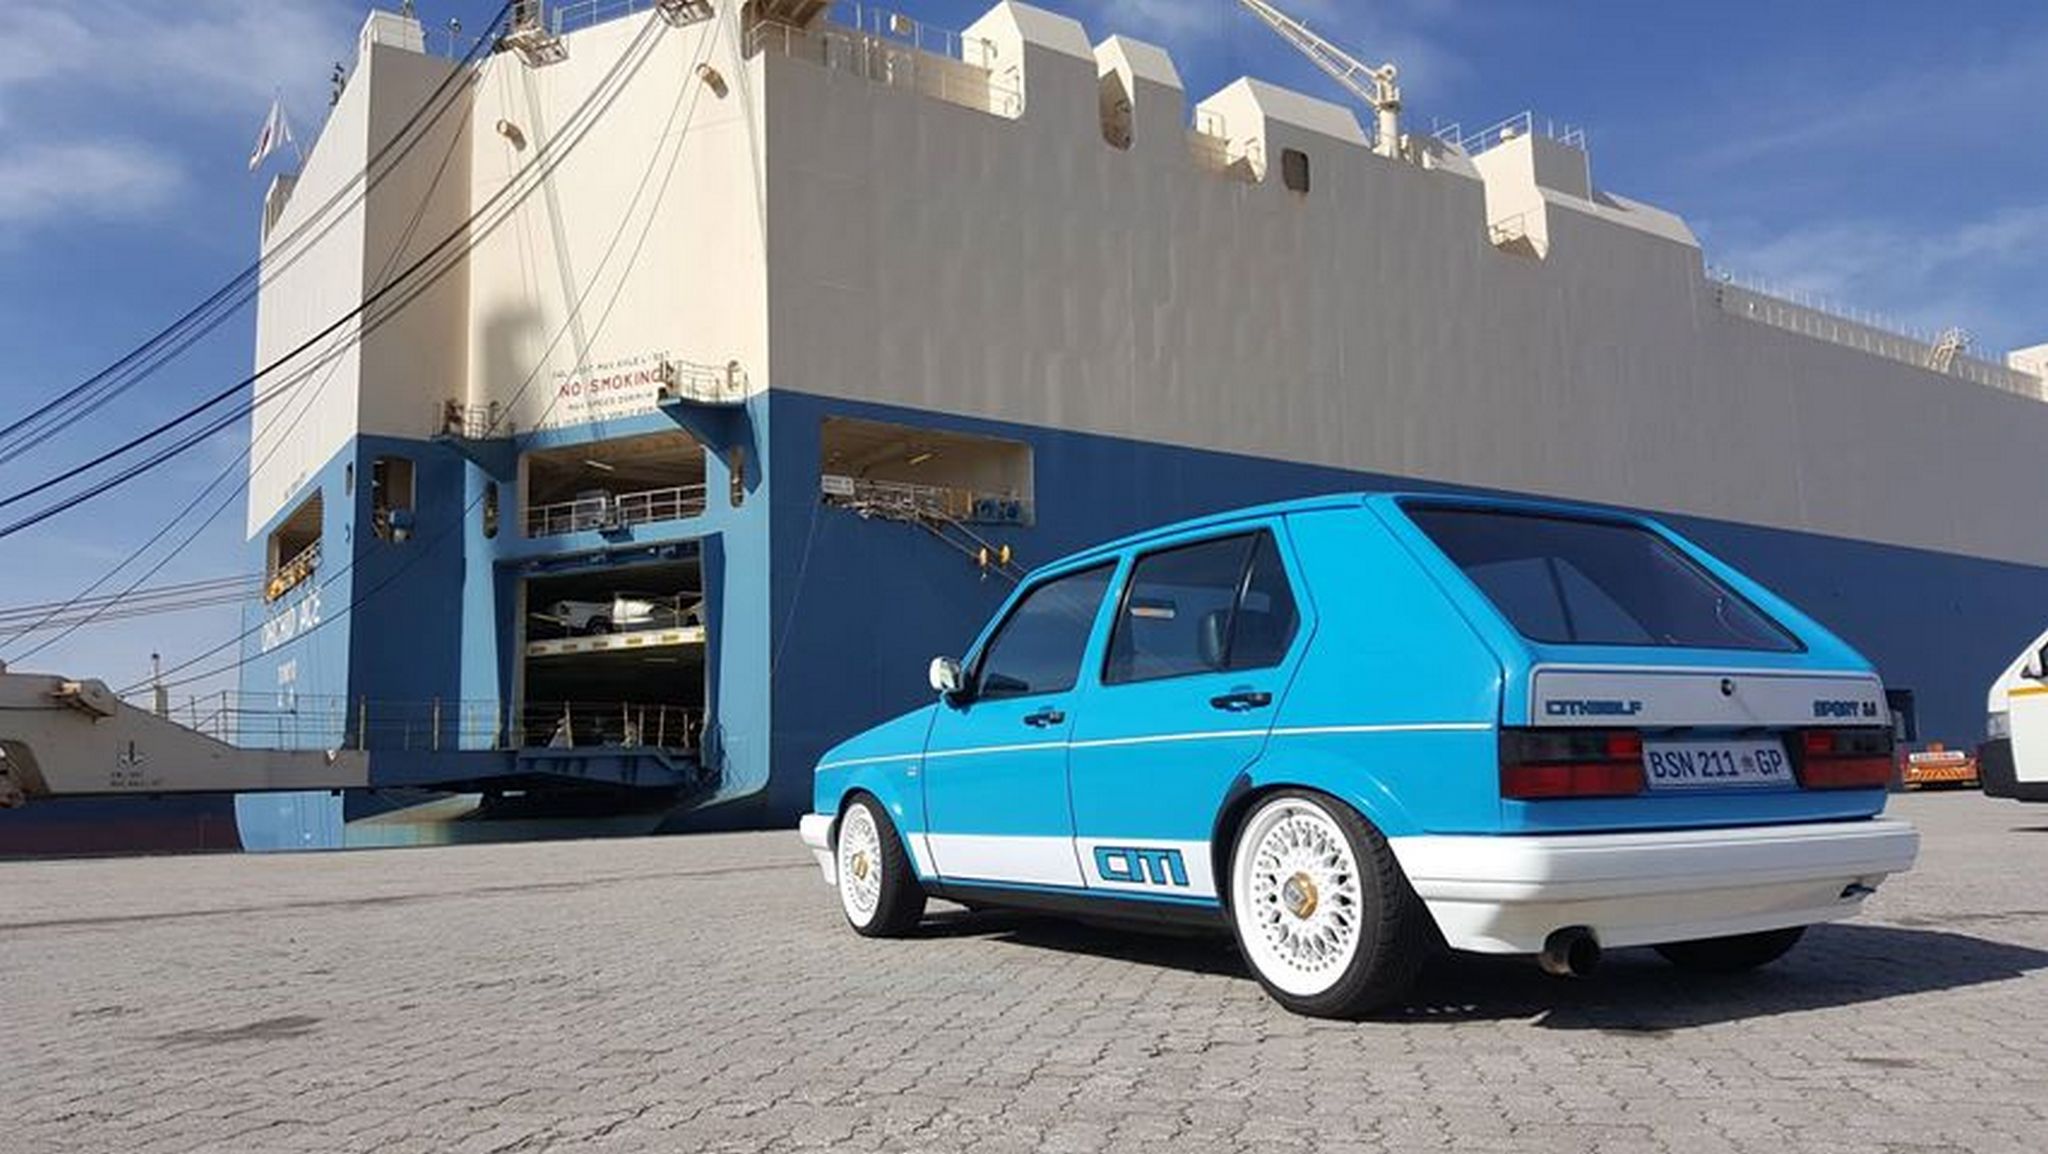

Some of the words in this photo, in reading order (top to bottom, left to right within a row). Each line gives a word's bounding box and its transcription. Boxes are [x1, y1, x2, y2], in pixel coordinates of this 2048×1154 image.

[559, 382, 580, 398] NO
[1648, 751, 1696, 778] BSN
[1697, 750, 1740, 777] 211
[1754, 749, 1783, 776] GP
[1093, 846, 1190, 886] CITI
